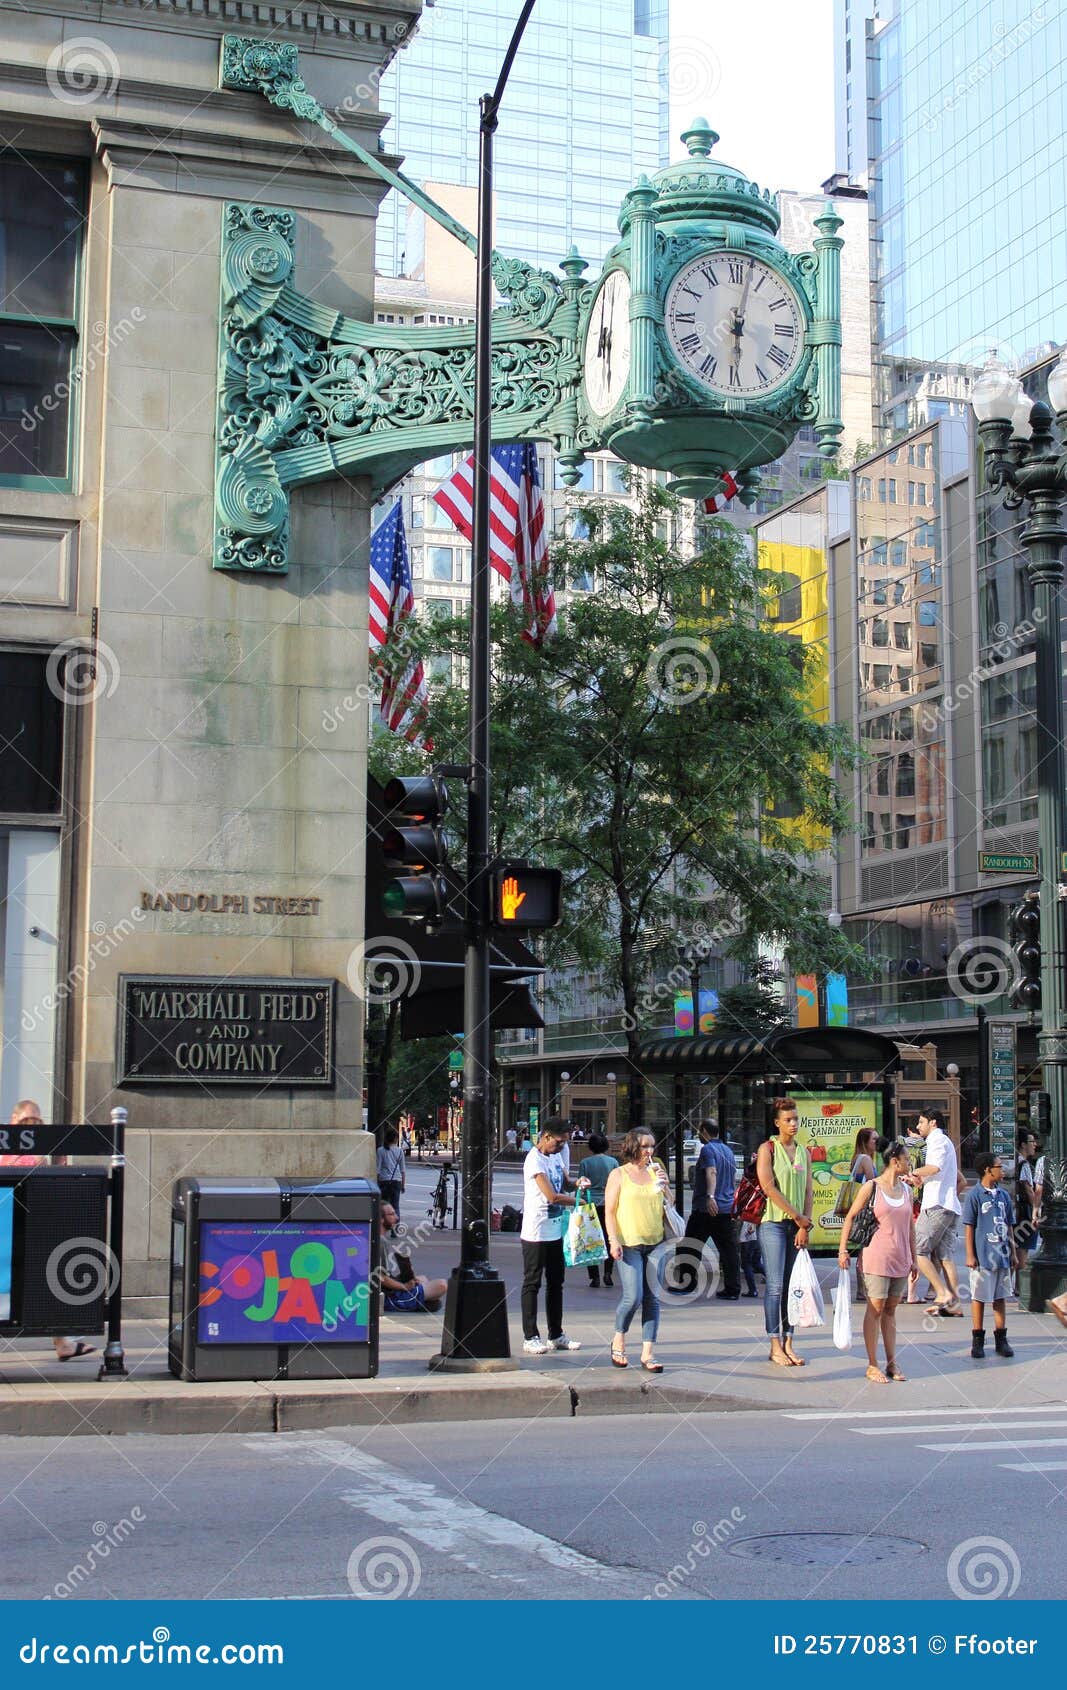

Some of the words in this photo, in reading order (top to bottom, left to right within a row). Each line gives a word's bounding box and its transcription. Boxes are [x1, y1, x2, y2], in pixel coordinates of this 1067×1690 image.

[701, 266, 719, 289] XI
[728, 263, 743, 285] XII
[682, 284, 702, 302] X
[754, 276, 766, 292] I
[768, 298, 787, 312] II
[775, 324, 793, 337] III
[984, 857, 1021, 867] RANDOLPH
[140, 891, 248, 914] RANDOLPH
[253, 896, 322, 915] STREET
[139, 992, 251, 1020] MARSHALL
[260, 994, 317, 1021] FIELD
[208, 1025, 249, 1039] AND
[176, 1043, 282, 1071] COMPANY
[800, 1116, 867, 1128] MEDITERRANEAN
[811, 1126, 852, 1138] SANDWICH
[200, 1236, 369, 1306] COLOR
[243, 1276, 369, 1327] JAM
